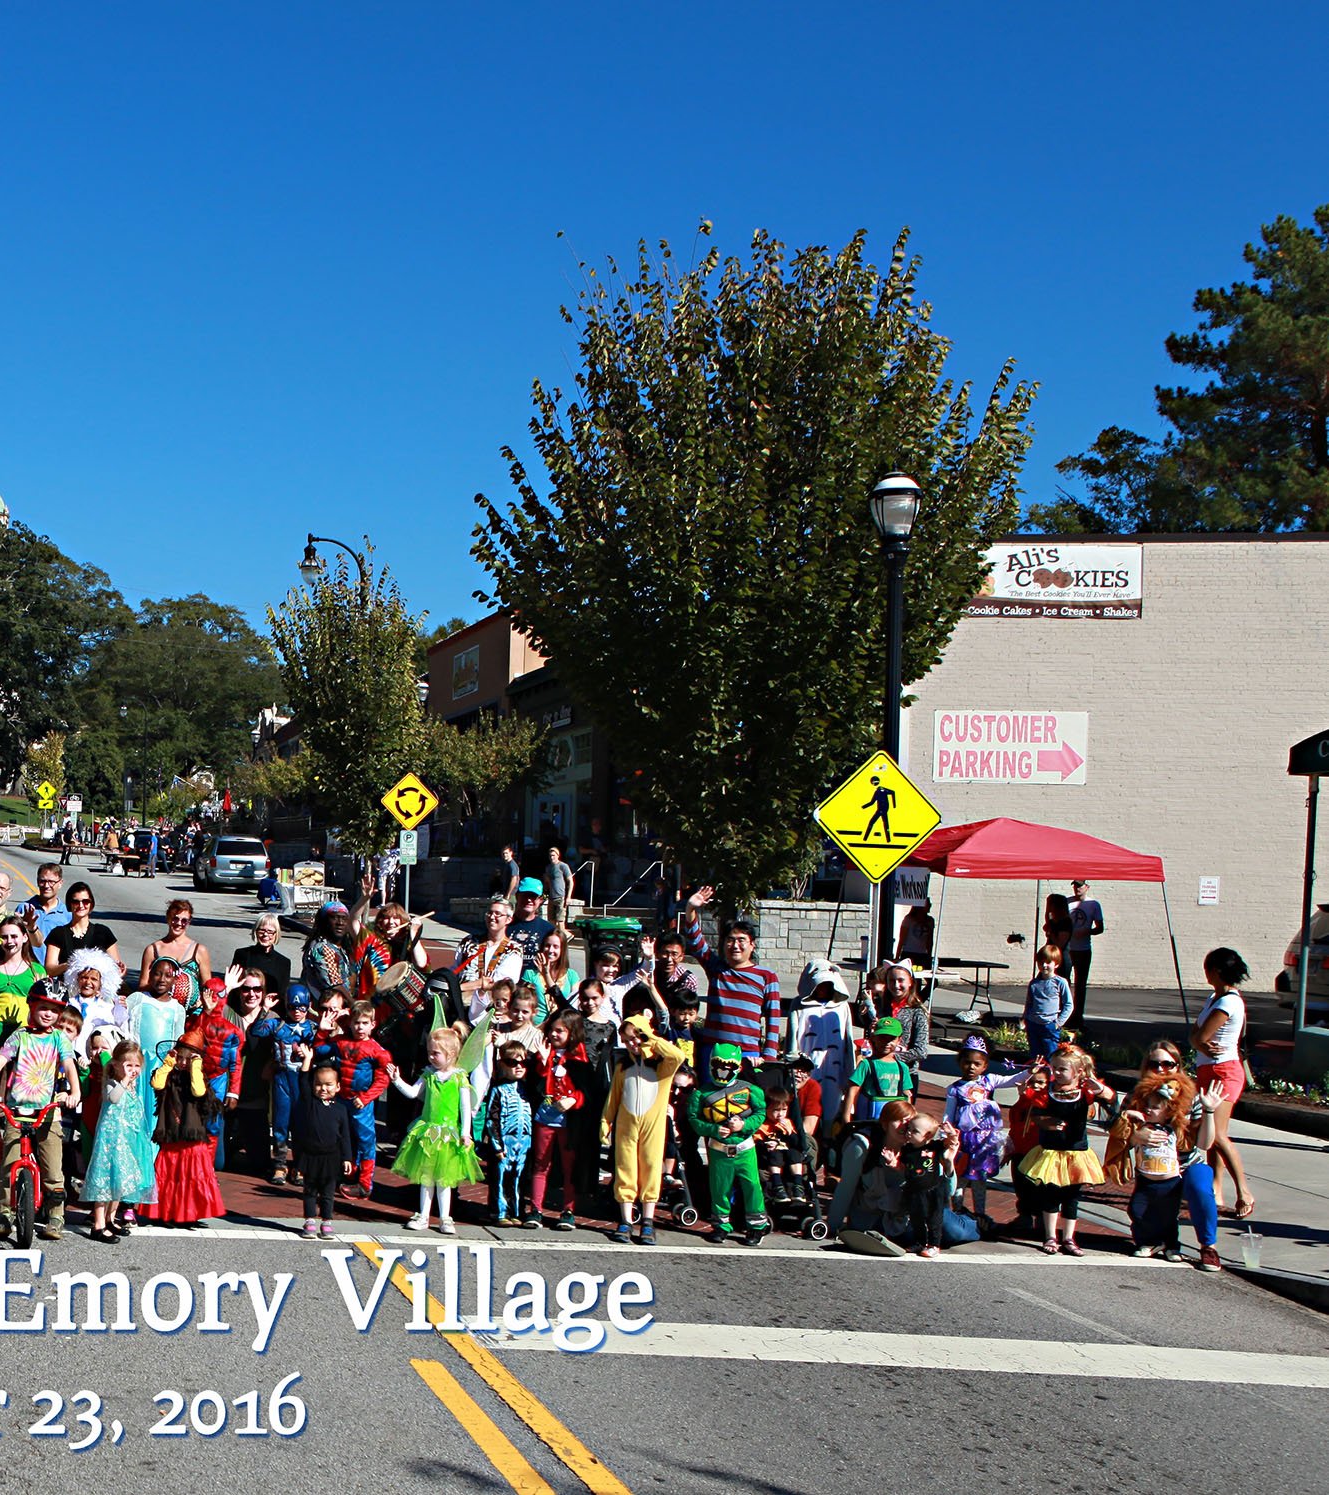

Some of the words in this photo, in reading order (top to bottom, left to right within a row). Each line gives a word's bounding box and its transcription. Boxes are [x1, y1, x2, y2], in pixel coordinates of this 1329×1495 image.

[1006, 547, 1060, 572] Ali's
[1043, 590, 1071, 598] Cookies
[1073, 590, 1092, 598] You'll
[967, 605, 1000, 616] Cookie
[1002, 606, 1032, 616] Cakes
[1042, 606, 1058, 616] Ice
[1060, 606, 1094, 616] Cream
[1103, 606, 1139, 617] Shakes
[939, 714, 1058, 743] CUSTOMER
[938, 749, 1033, 779] PARKING
